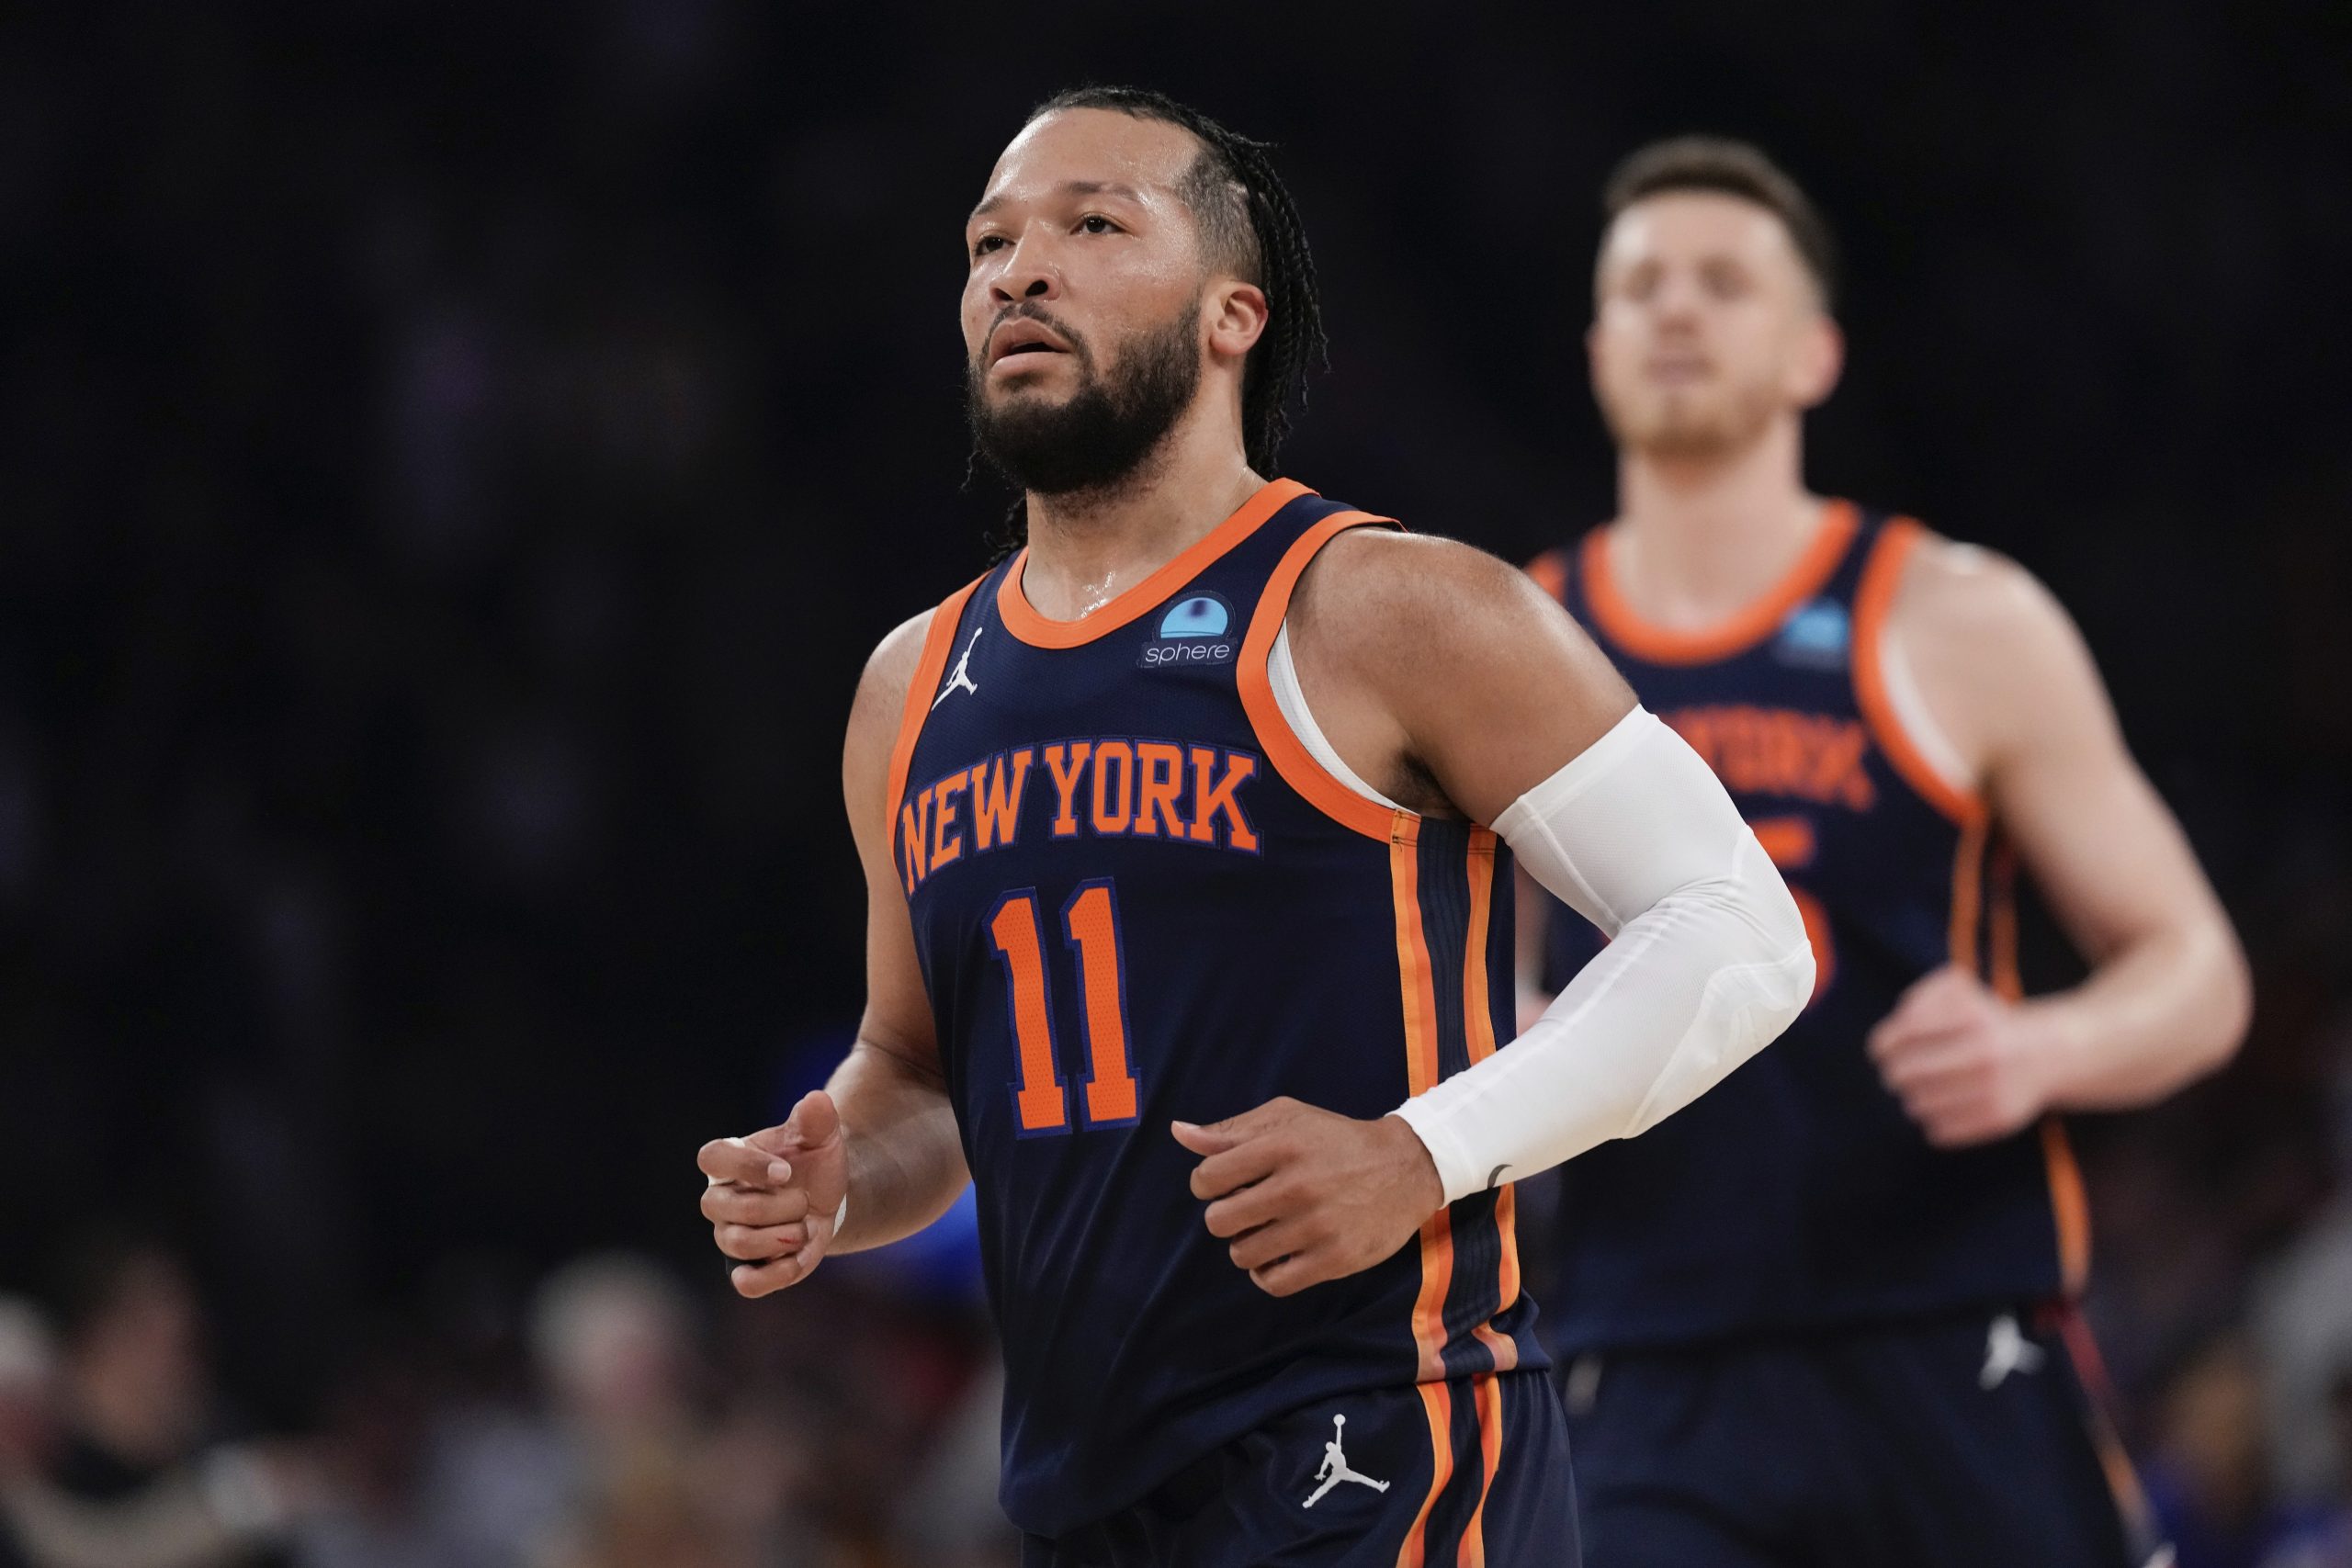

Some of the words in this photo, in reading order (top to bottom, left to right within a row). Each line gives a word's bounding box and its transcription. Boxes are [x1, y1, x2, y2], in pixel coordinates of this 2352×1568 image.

[1145, 643, 1230, 665] sphere
[901, 746, 1035, 897] NEW
[1042, 738, 1262, 856] YORK
[985, 880, 1139, 1136] 11
